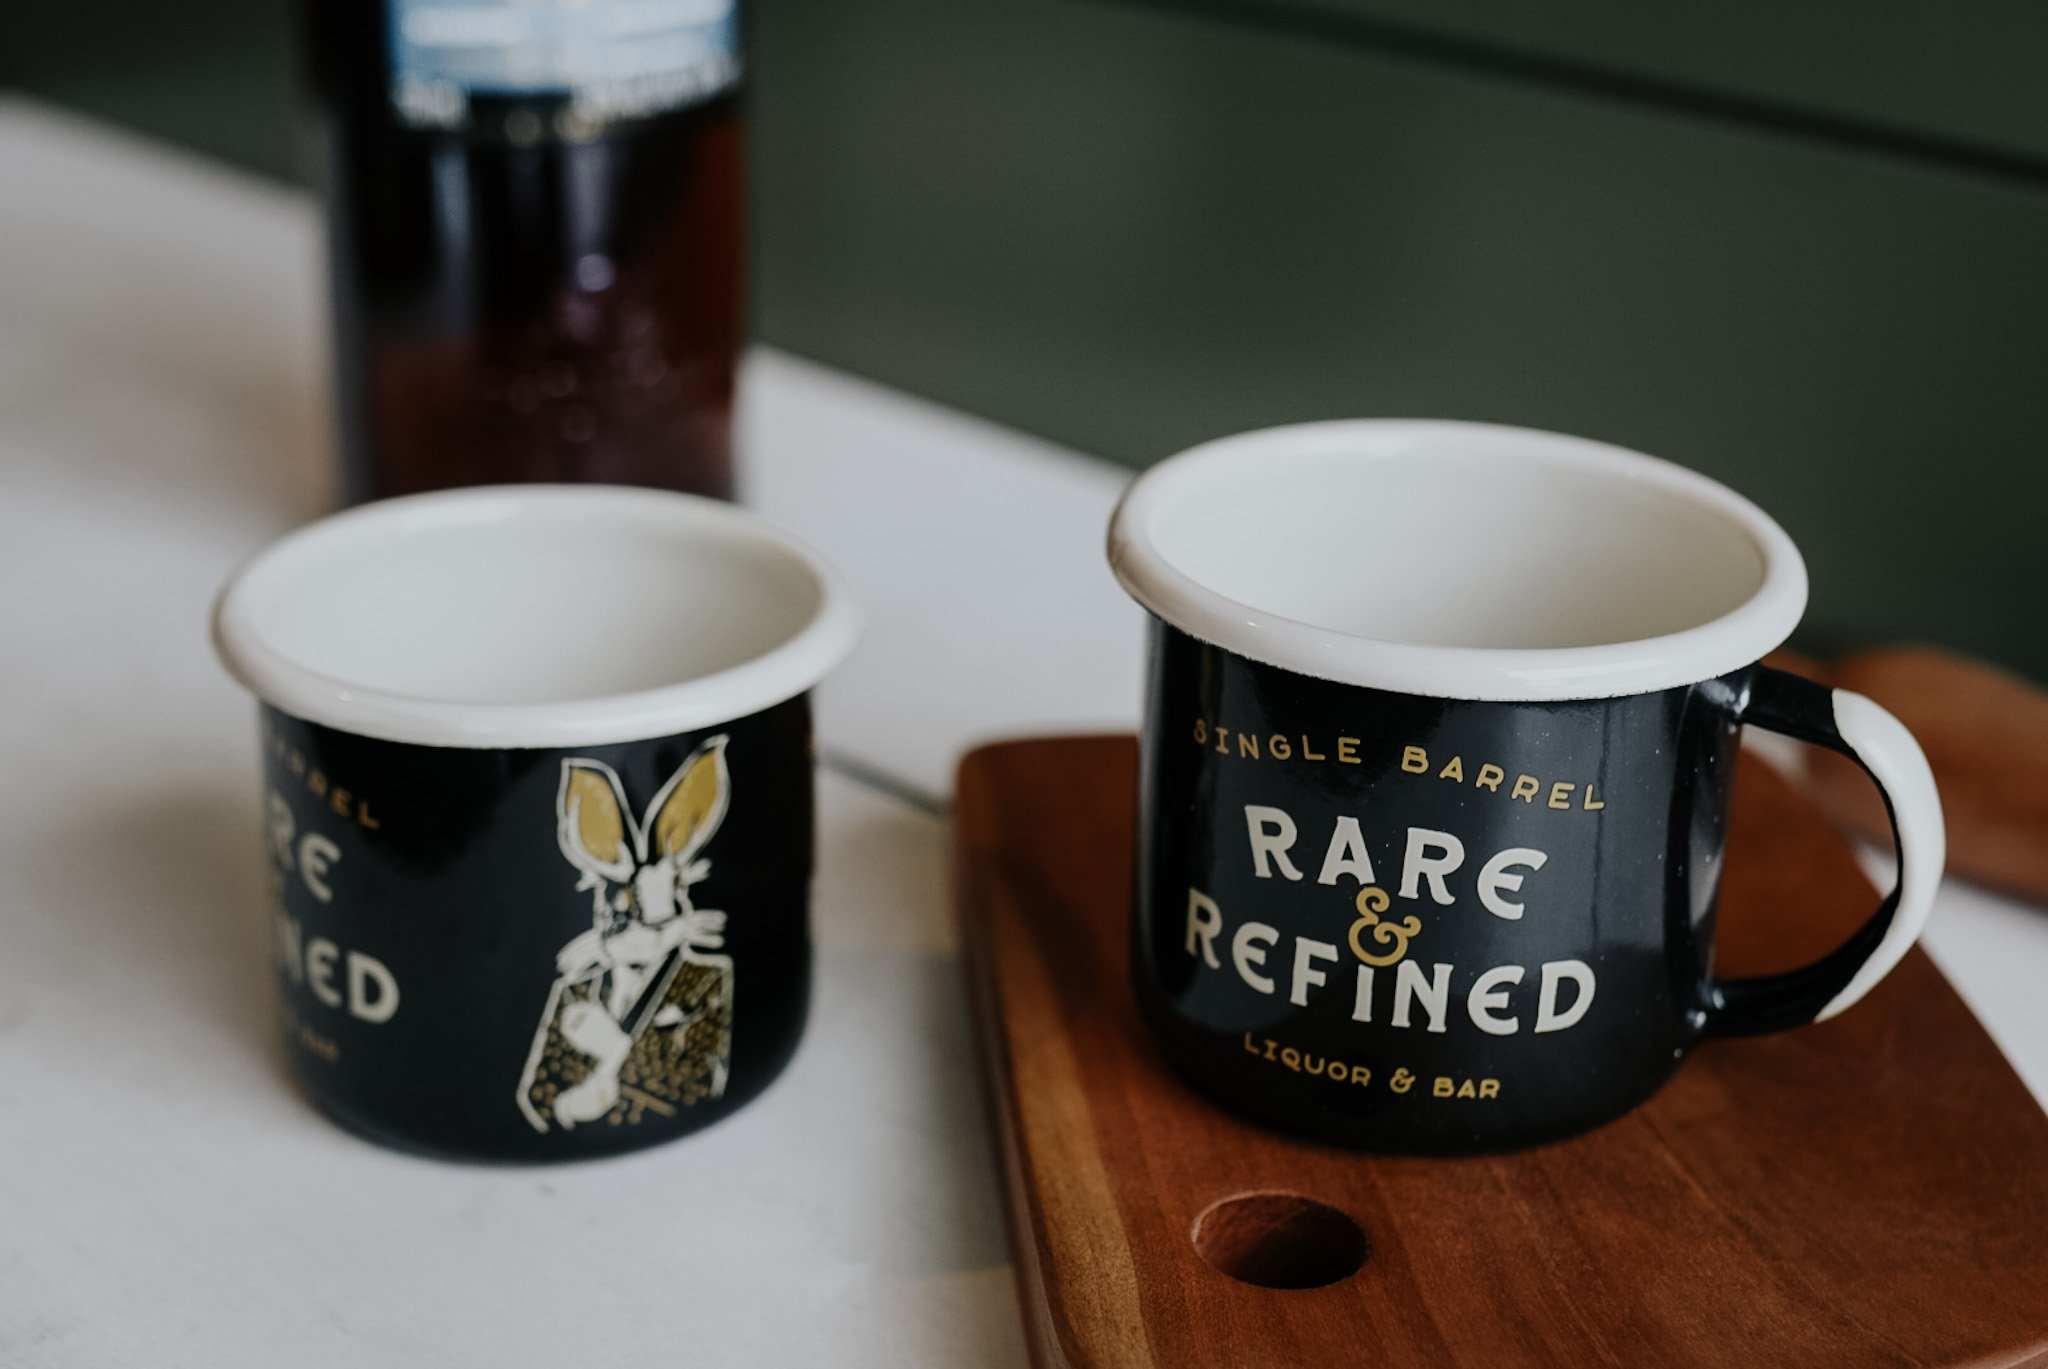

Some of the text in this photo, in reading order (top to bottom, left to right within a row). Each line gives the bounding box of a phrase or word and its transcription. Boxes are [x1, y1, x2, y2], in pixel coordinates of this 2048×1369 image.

[1192, 717, 1606, 811] SINGLE BARREL
[1243, 804, 1549, 921] RARE
[1184, 886, 1597, 1036] REFINED
[1347, 885, 1423, 967] &
[1243, 1031, 1502, 1100] LIQUOR & BAR
